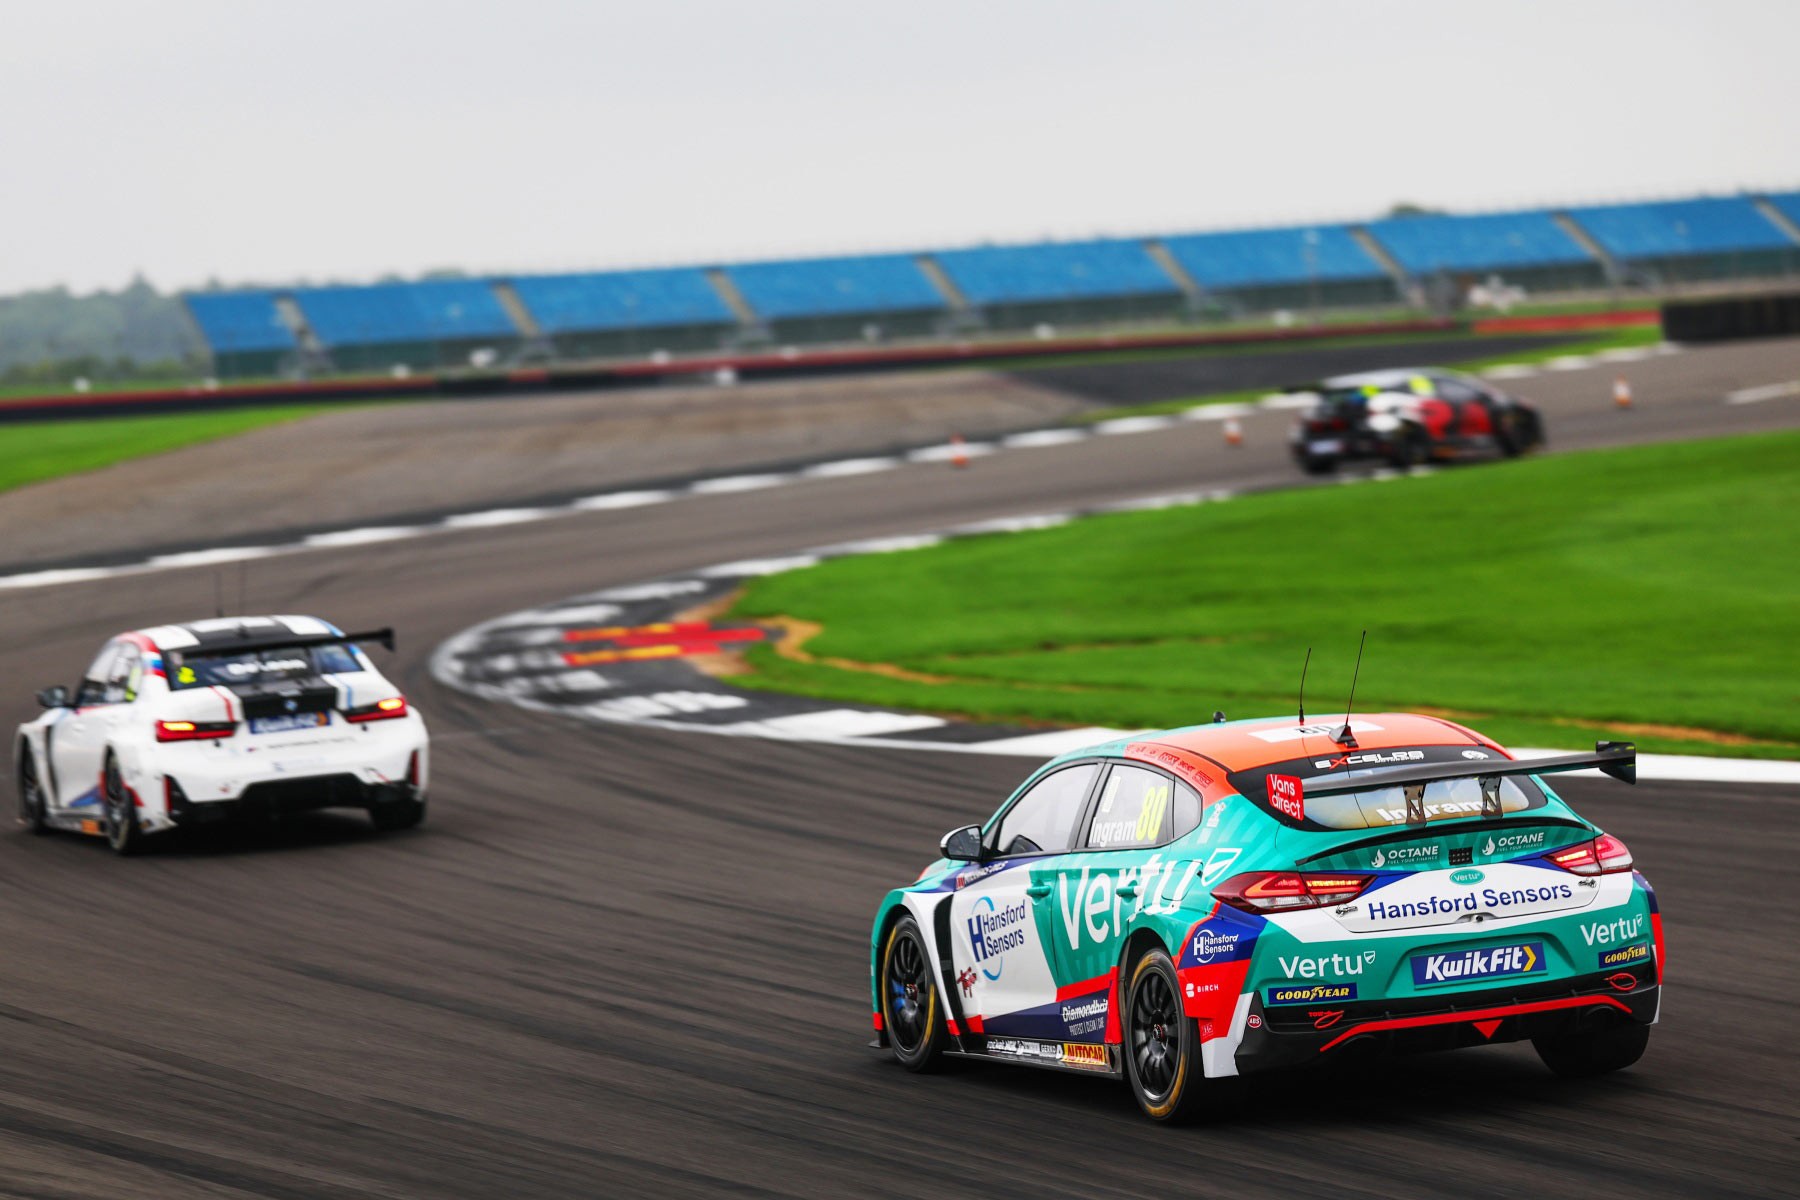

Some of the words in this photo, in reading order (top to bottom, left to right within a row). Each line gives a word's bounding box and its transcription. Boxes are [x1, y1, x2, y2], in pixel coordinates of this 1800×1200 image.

[1270, 774, 1296, 797] Vans
[1135, 785, 1169, 841] 80
[1271, 795, 1301, 819] direct
[1088, 815, 1137, 848] Ingram
[1498, 832, 1545, 847] OCTANE
[1388, 845, 1439, 859] OCTANE
[1454, 873, 1480, 882] Vertu
[1059, 854, 1203, 950] Vertu
[1368, 892, 1478, 921] Hansford
[1482, 884, 1573, 908] Sensors
[982, 899, 1026, 935] Hansford
[1204, 933, 1239, 946] Hansford
[1580, 917, 1638, 946] Vertu
[986, 928, 1025, 959] Sensors
[1204, 943, 1234, 955] Sensors
[1604, 946, 1647, 963] GOODYEAR
[1278, 953, 1364, 979] Vertu
[1197, 983, 1219, 993] BIRCH
[1276, 986, 1350, 1001] GOODYEAR
[1067, 1045, 1104, 1061] AUTOCAR
